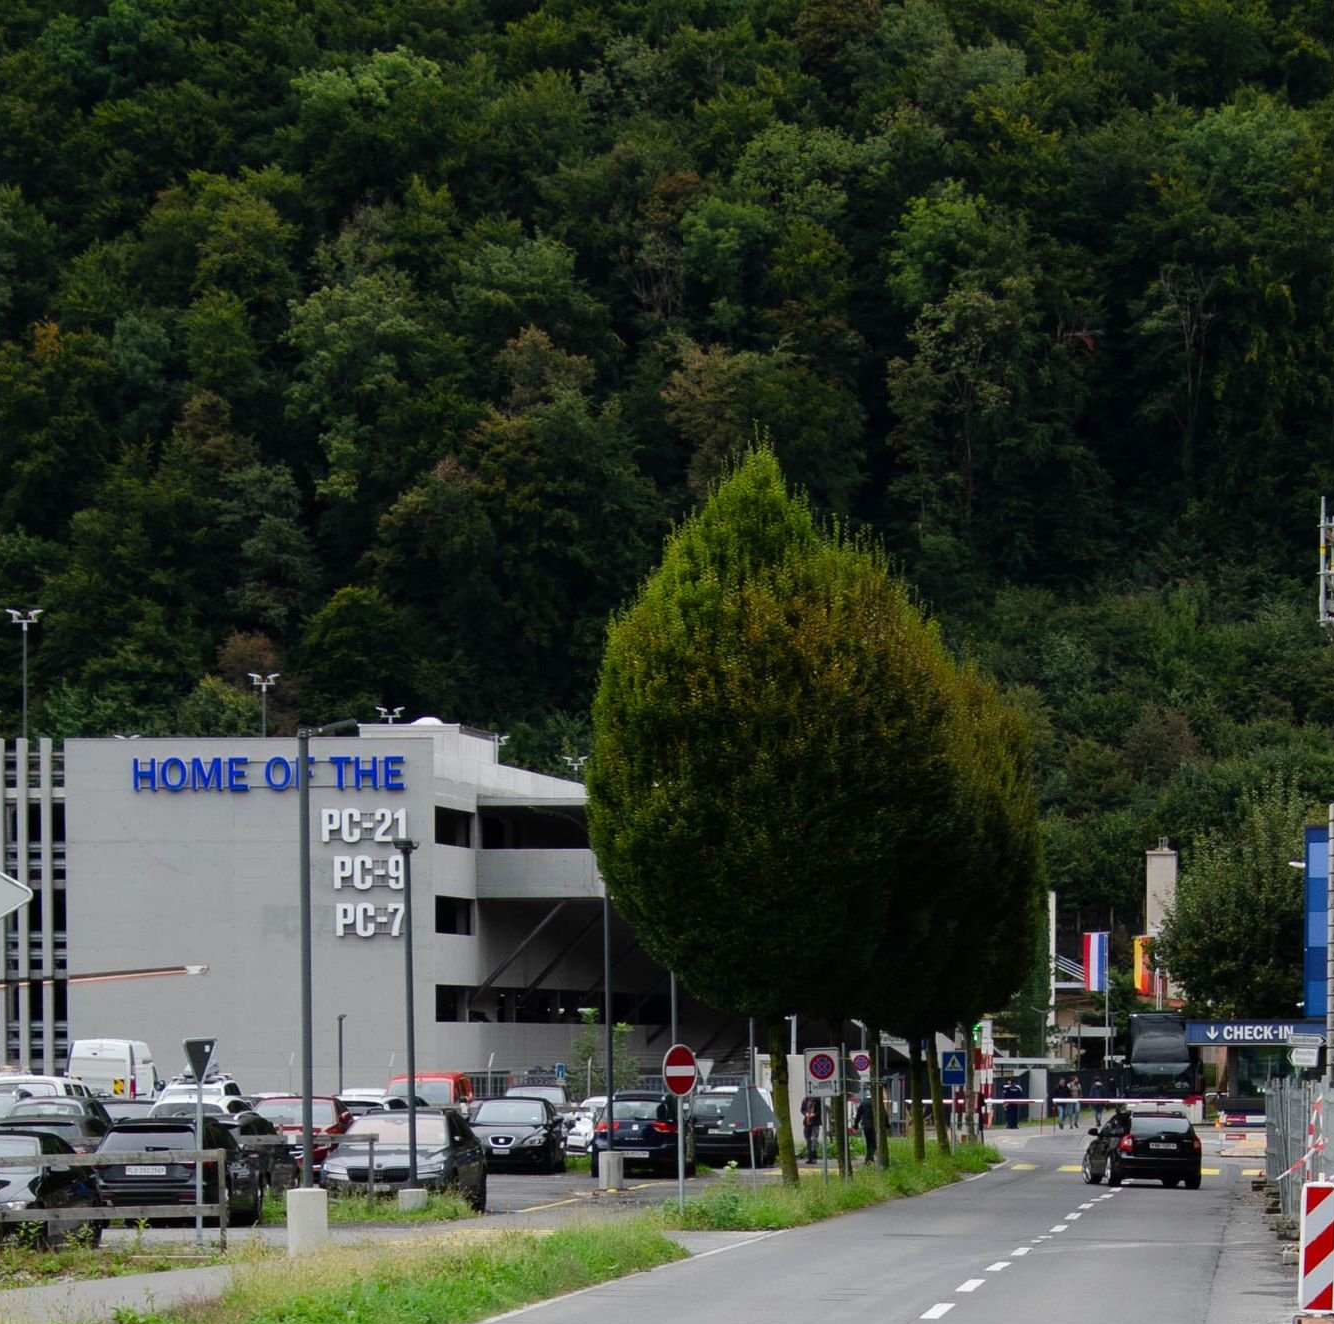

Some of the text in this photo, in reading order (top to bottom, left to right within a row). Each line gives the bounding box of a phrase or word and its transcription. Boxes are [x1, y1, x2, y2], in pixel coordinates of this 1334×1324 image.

[133, 757, 250, 792] HOME
[329, 756, 406, 791] THE
[321, 807, 407, 843] PC-21
[333, 855, 405, 890] PC-9
[336, 903, 405, 936] PC-7
[1223, 1025, 1294, 1040] CHECK-IN
